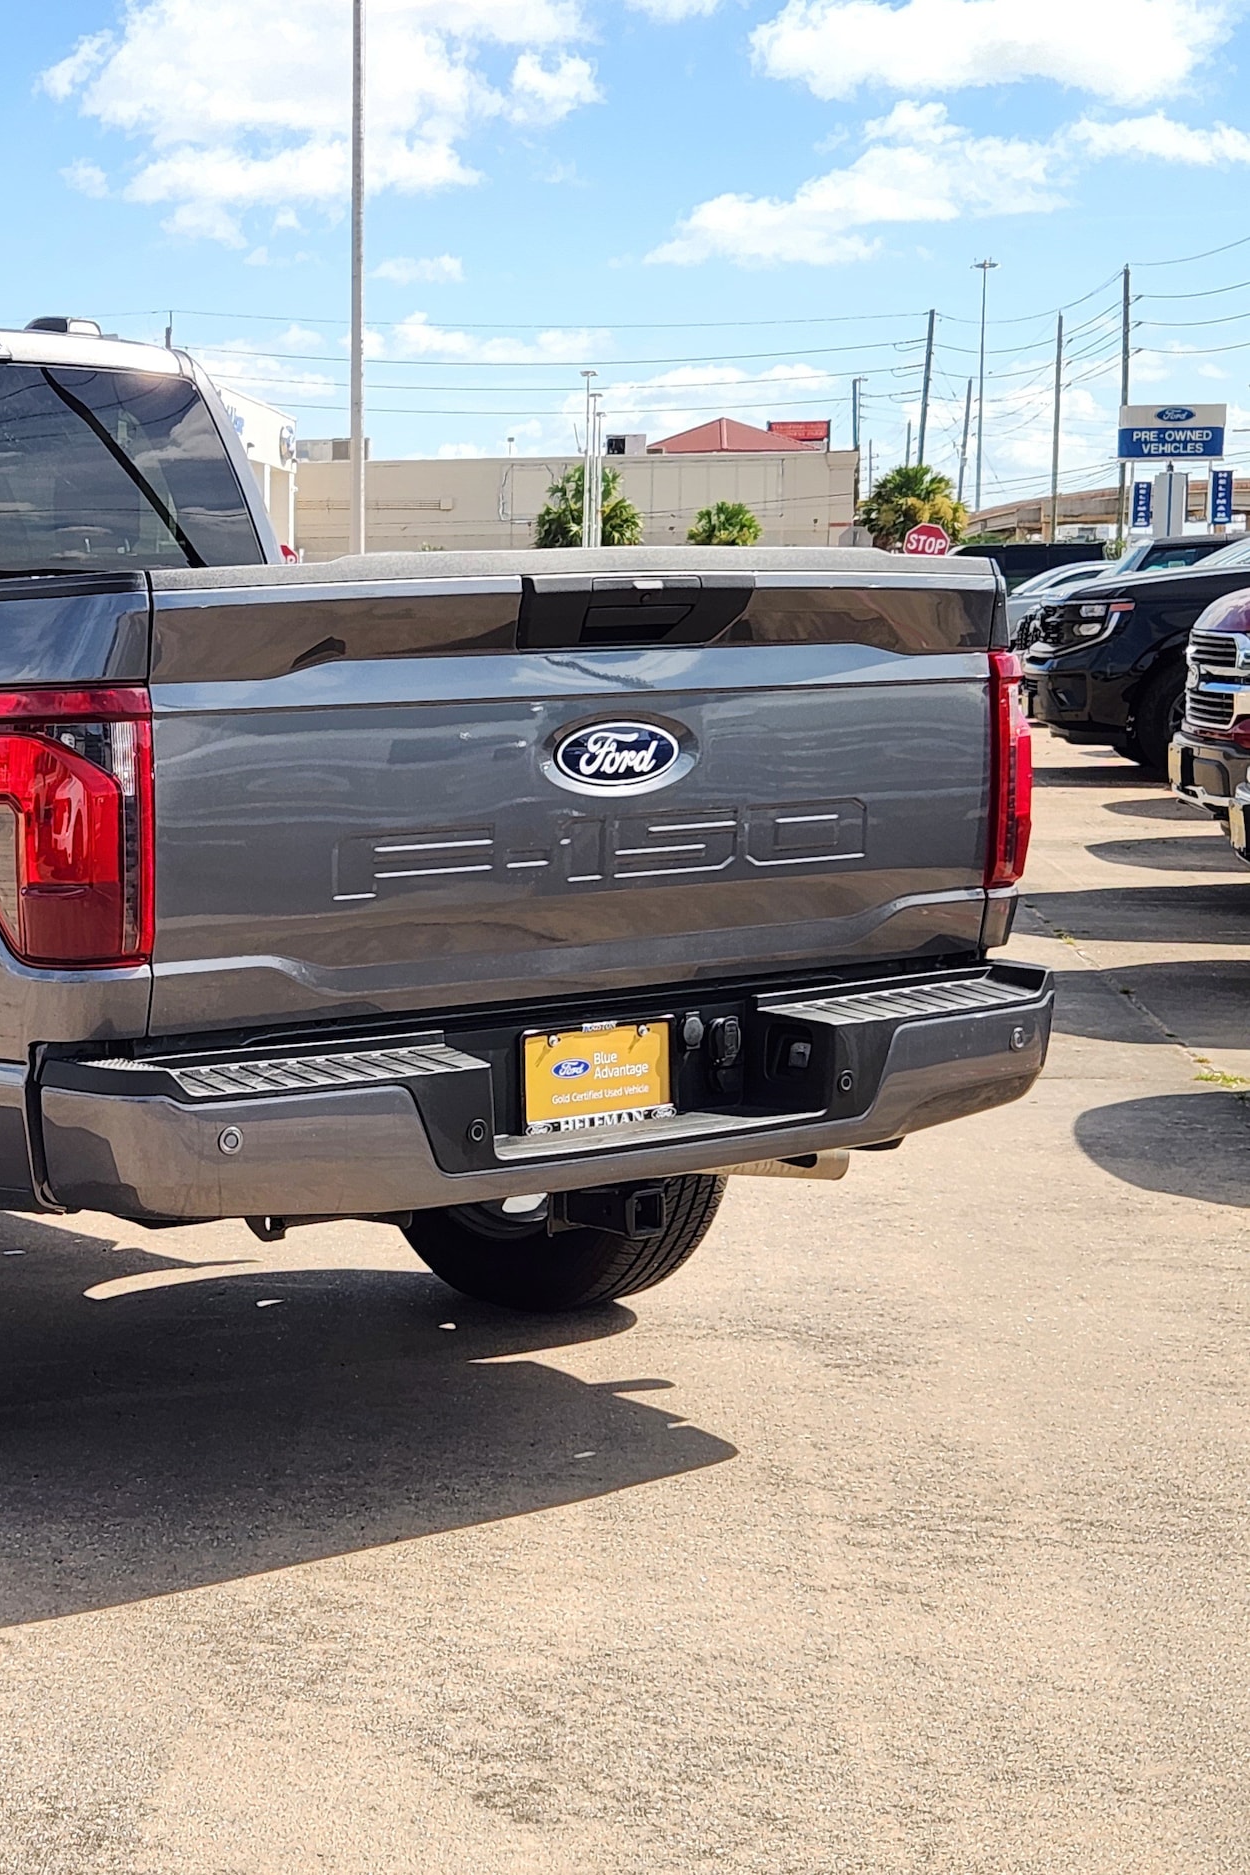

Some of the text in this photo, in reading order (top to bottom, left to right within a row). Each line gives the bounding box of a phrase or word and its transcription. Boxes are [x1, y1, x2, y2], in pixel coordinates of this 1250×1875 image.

[1162, 409, 1188, 420] Ford
[1142, 443, 1204, 454] VEHICLES
[907, 533, 946, 554] STOP
[579, 731, 659, 775] Ford
[332, 797, 868, 901] F-150
[593, 1052, 618, 1065] Blue
[594, 1063, 649, 1080] Advantage
[552, 1084, 649, 1105] Gold Certified Used Vehicle
